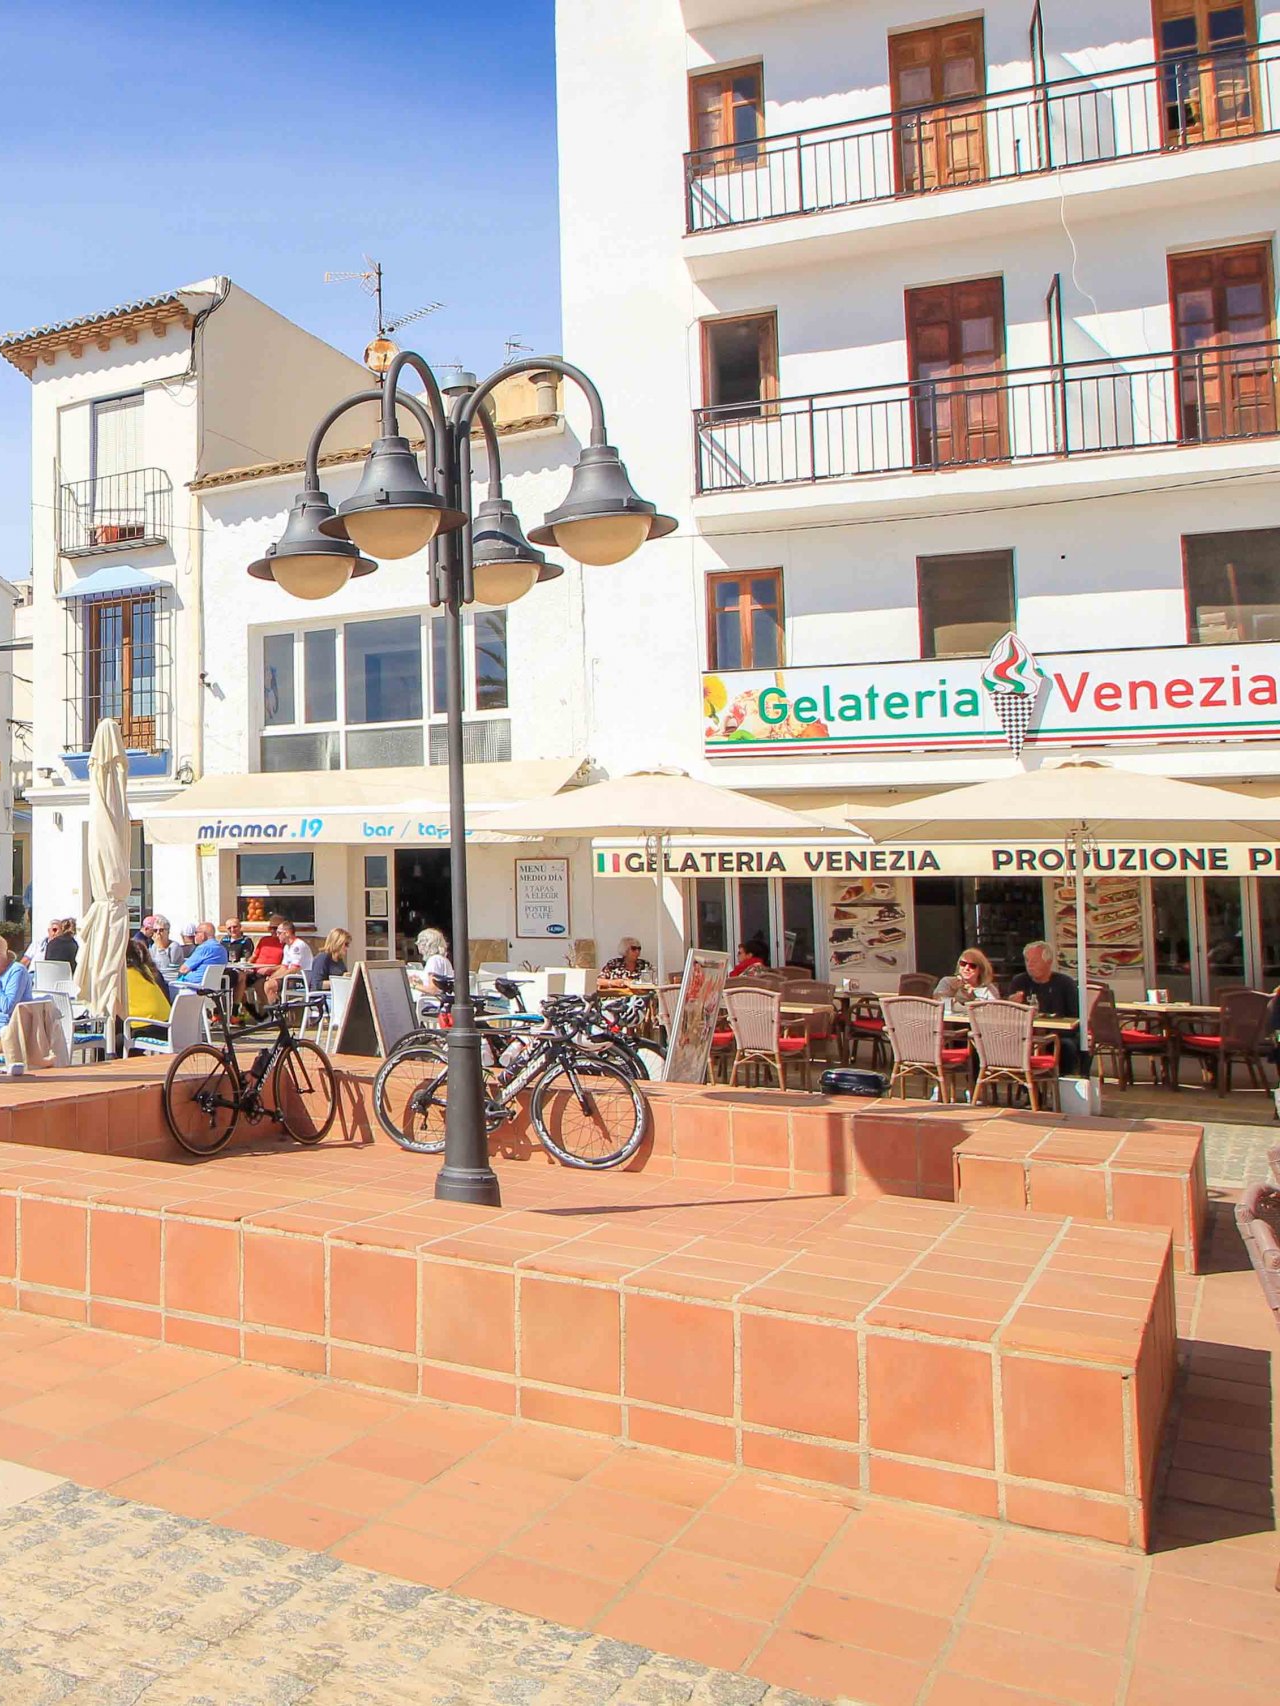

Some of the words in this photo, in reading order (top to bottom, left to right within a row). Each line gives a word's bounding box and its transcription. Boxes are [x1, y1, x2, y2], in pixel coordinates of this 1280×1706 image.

[758, 678, 980, 726] Gelateria
[1054, 664, 1279, 714] Venezia
[197, 820, 288, 839] miramar
[363, 822, 394, 837] bar
[418, 822, 472, 839] tap
[624, 851, 786, 873] GELATERIA
[804, 850, 940, 872] VENEZIA
[992, 848, 1228, 871] PRODUZIONE
[1248, 848, 1280, 871] P
[501, 1053, 546, 1100] MERIDA
